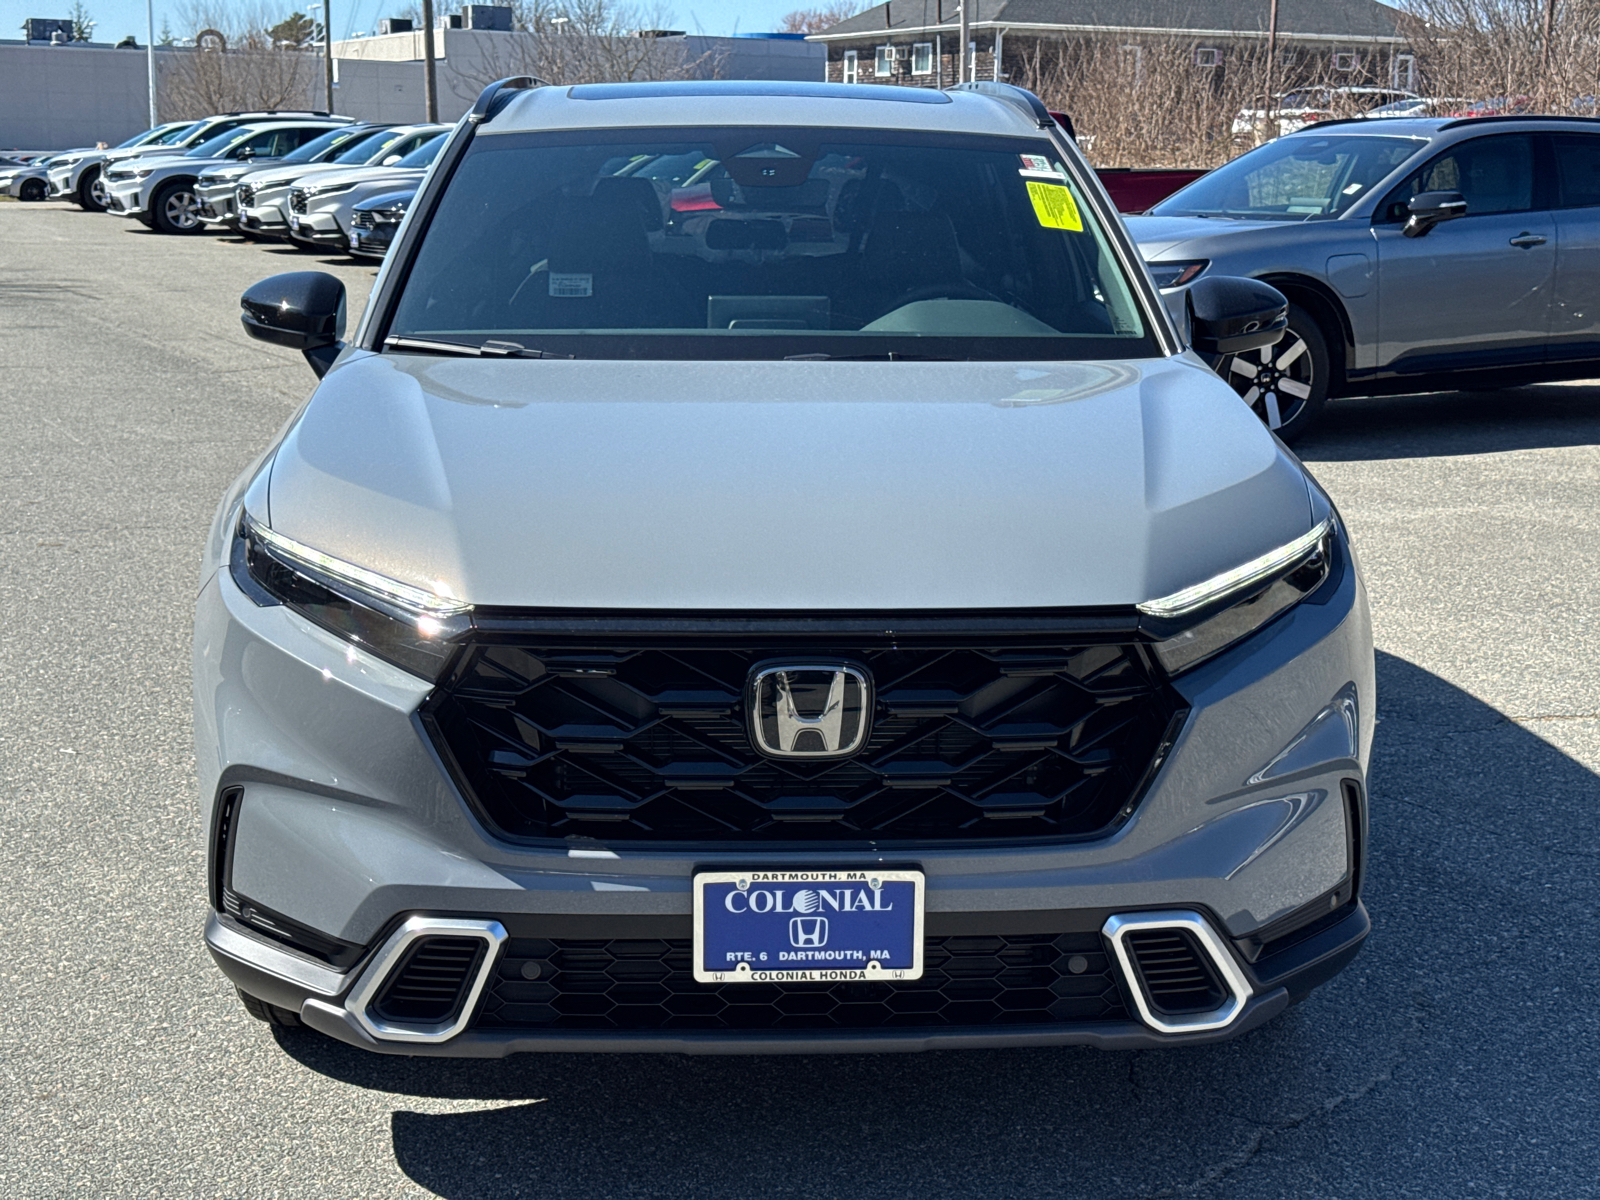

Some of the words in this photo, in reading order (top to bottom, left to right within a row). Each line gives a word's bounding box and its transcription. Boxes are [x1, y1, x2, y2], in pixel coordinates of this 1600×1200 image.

[752, 872, 841, 881] DARTMOUTH,
[847, 872, 867, 880] MA
[726, 952, 756, 961] RTE.
[760, 952, 768, 961] 6
[779, 951, 866, 961] DARTMOUTH,
[870, 950, 890, 959] MA
[751, 970, 815, 980] COLONIAL
[820, 970, 867, 980] HONDA
